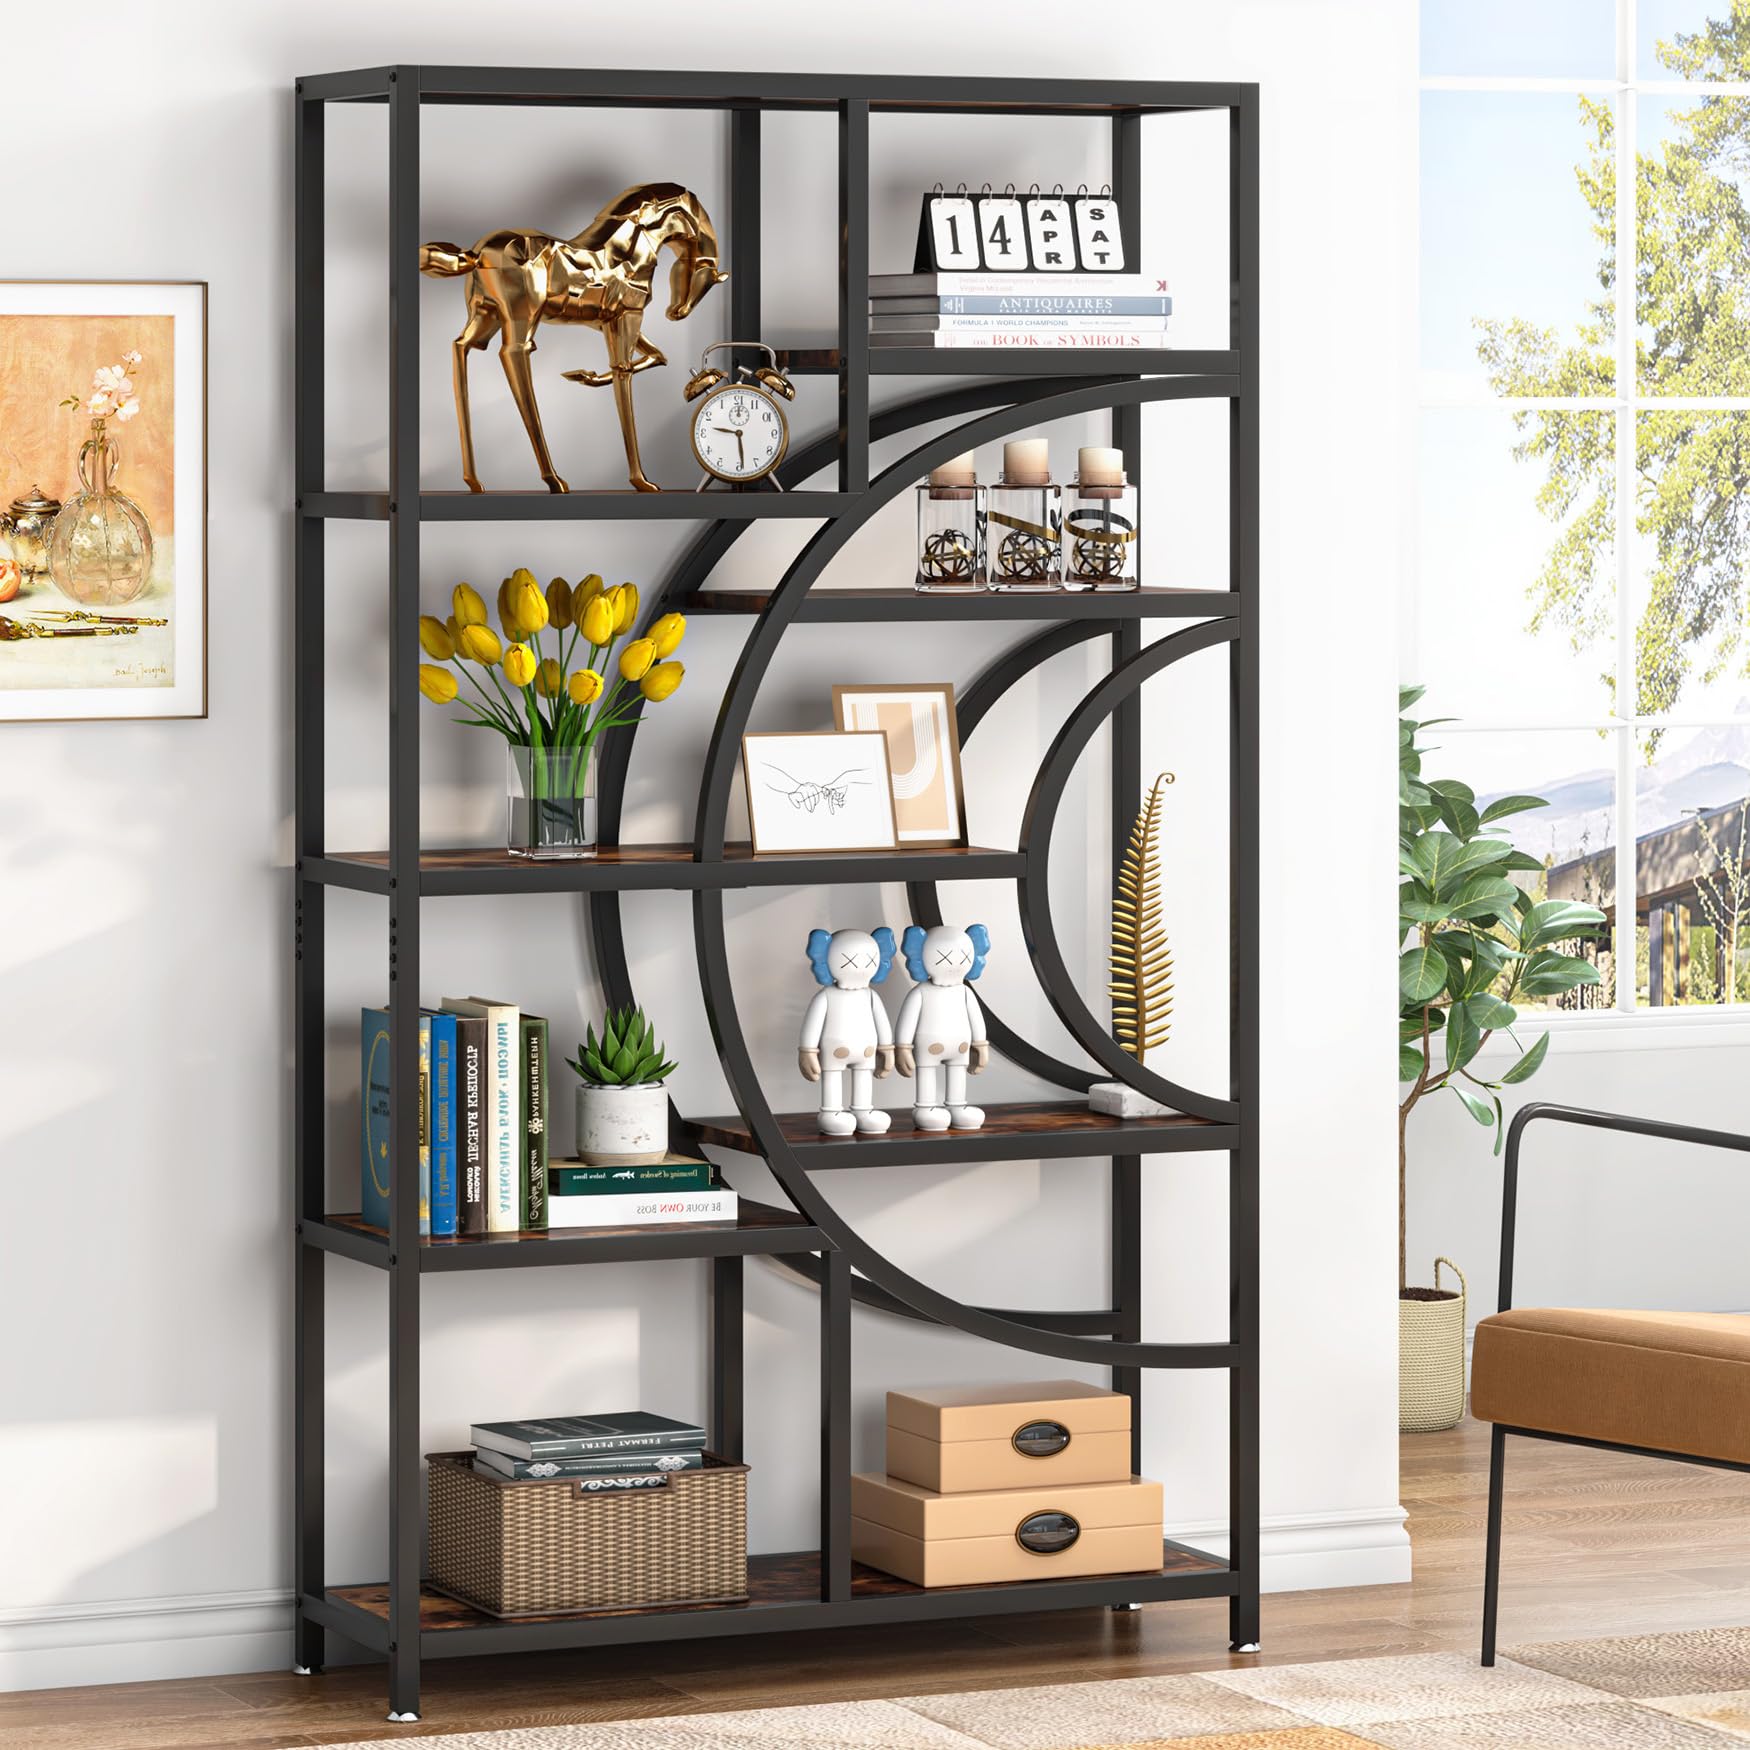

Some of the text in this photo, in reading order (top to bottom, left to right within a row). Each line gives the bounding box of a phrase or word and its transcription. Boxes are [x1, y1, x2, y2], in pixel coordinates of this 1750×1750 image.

[999, 297, 1113, 309] ANTIQUAIRES
[952, 319, 989, 327] FORMULA
[996, 319, 1024, 327] WORLD
[1024, 319, 1069, 327] CHAMPIONS
[992, 334, 1039, 346] BOOK
[1057, 334, 1141, 347] SYMBOLS
